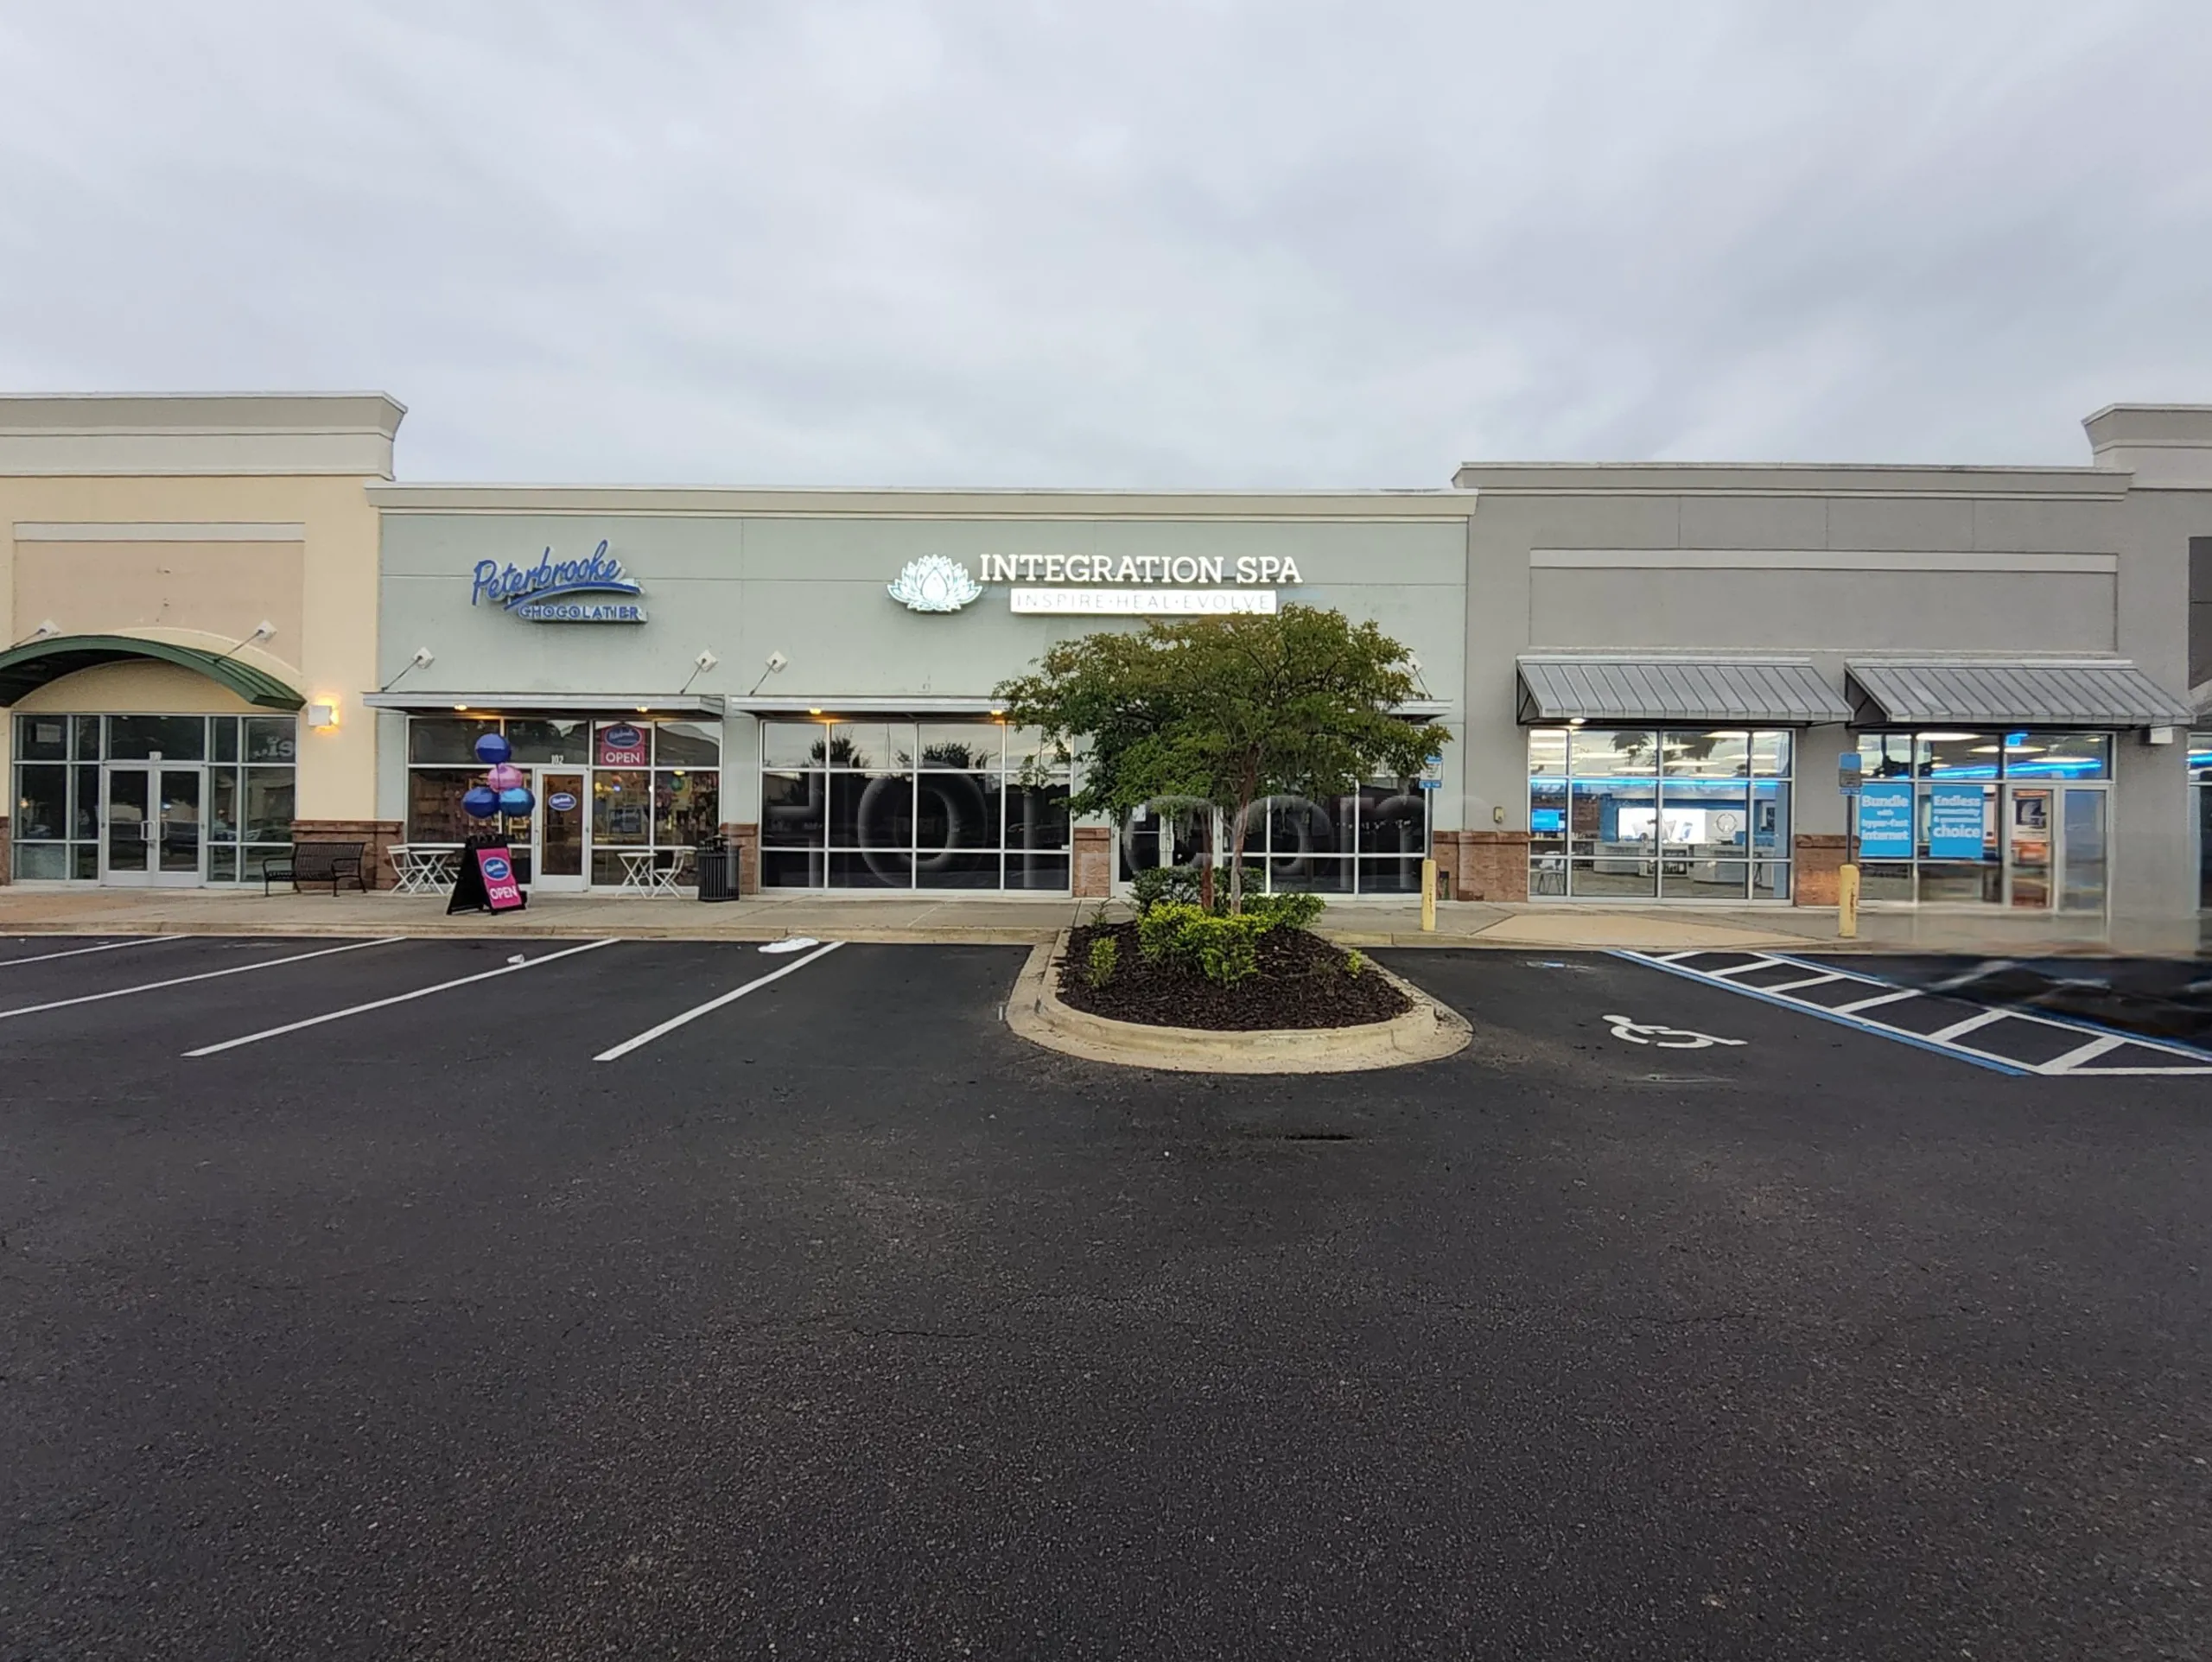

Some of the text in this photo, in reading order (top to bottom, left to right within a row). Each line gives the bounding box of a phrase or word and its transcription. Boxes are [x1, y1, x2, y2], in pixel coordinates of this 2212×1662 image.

[472, 539, 620, 606] Peterbrooke
[980, 554, 1303, 584] INTEGRATION SPA
[519, 605, 639, 619] CHOCOLATIER
[551, 754, 564, 766] 102
[605, 752, 640, 764] OPEN
[1933, 824, 1980, 838] choice
[490, 885, 518, 899] OPEN
